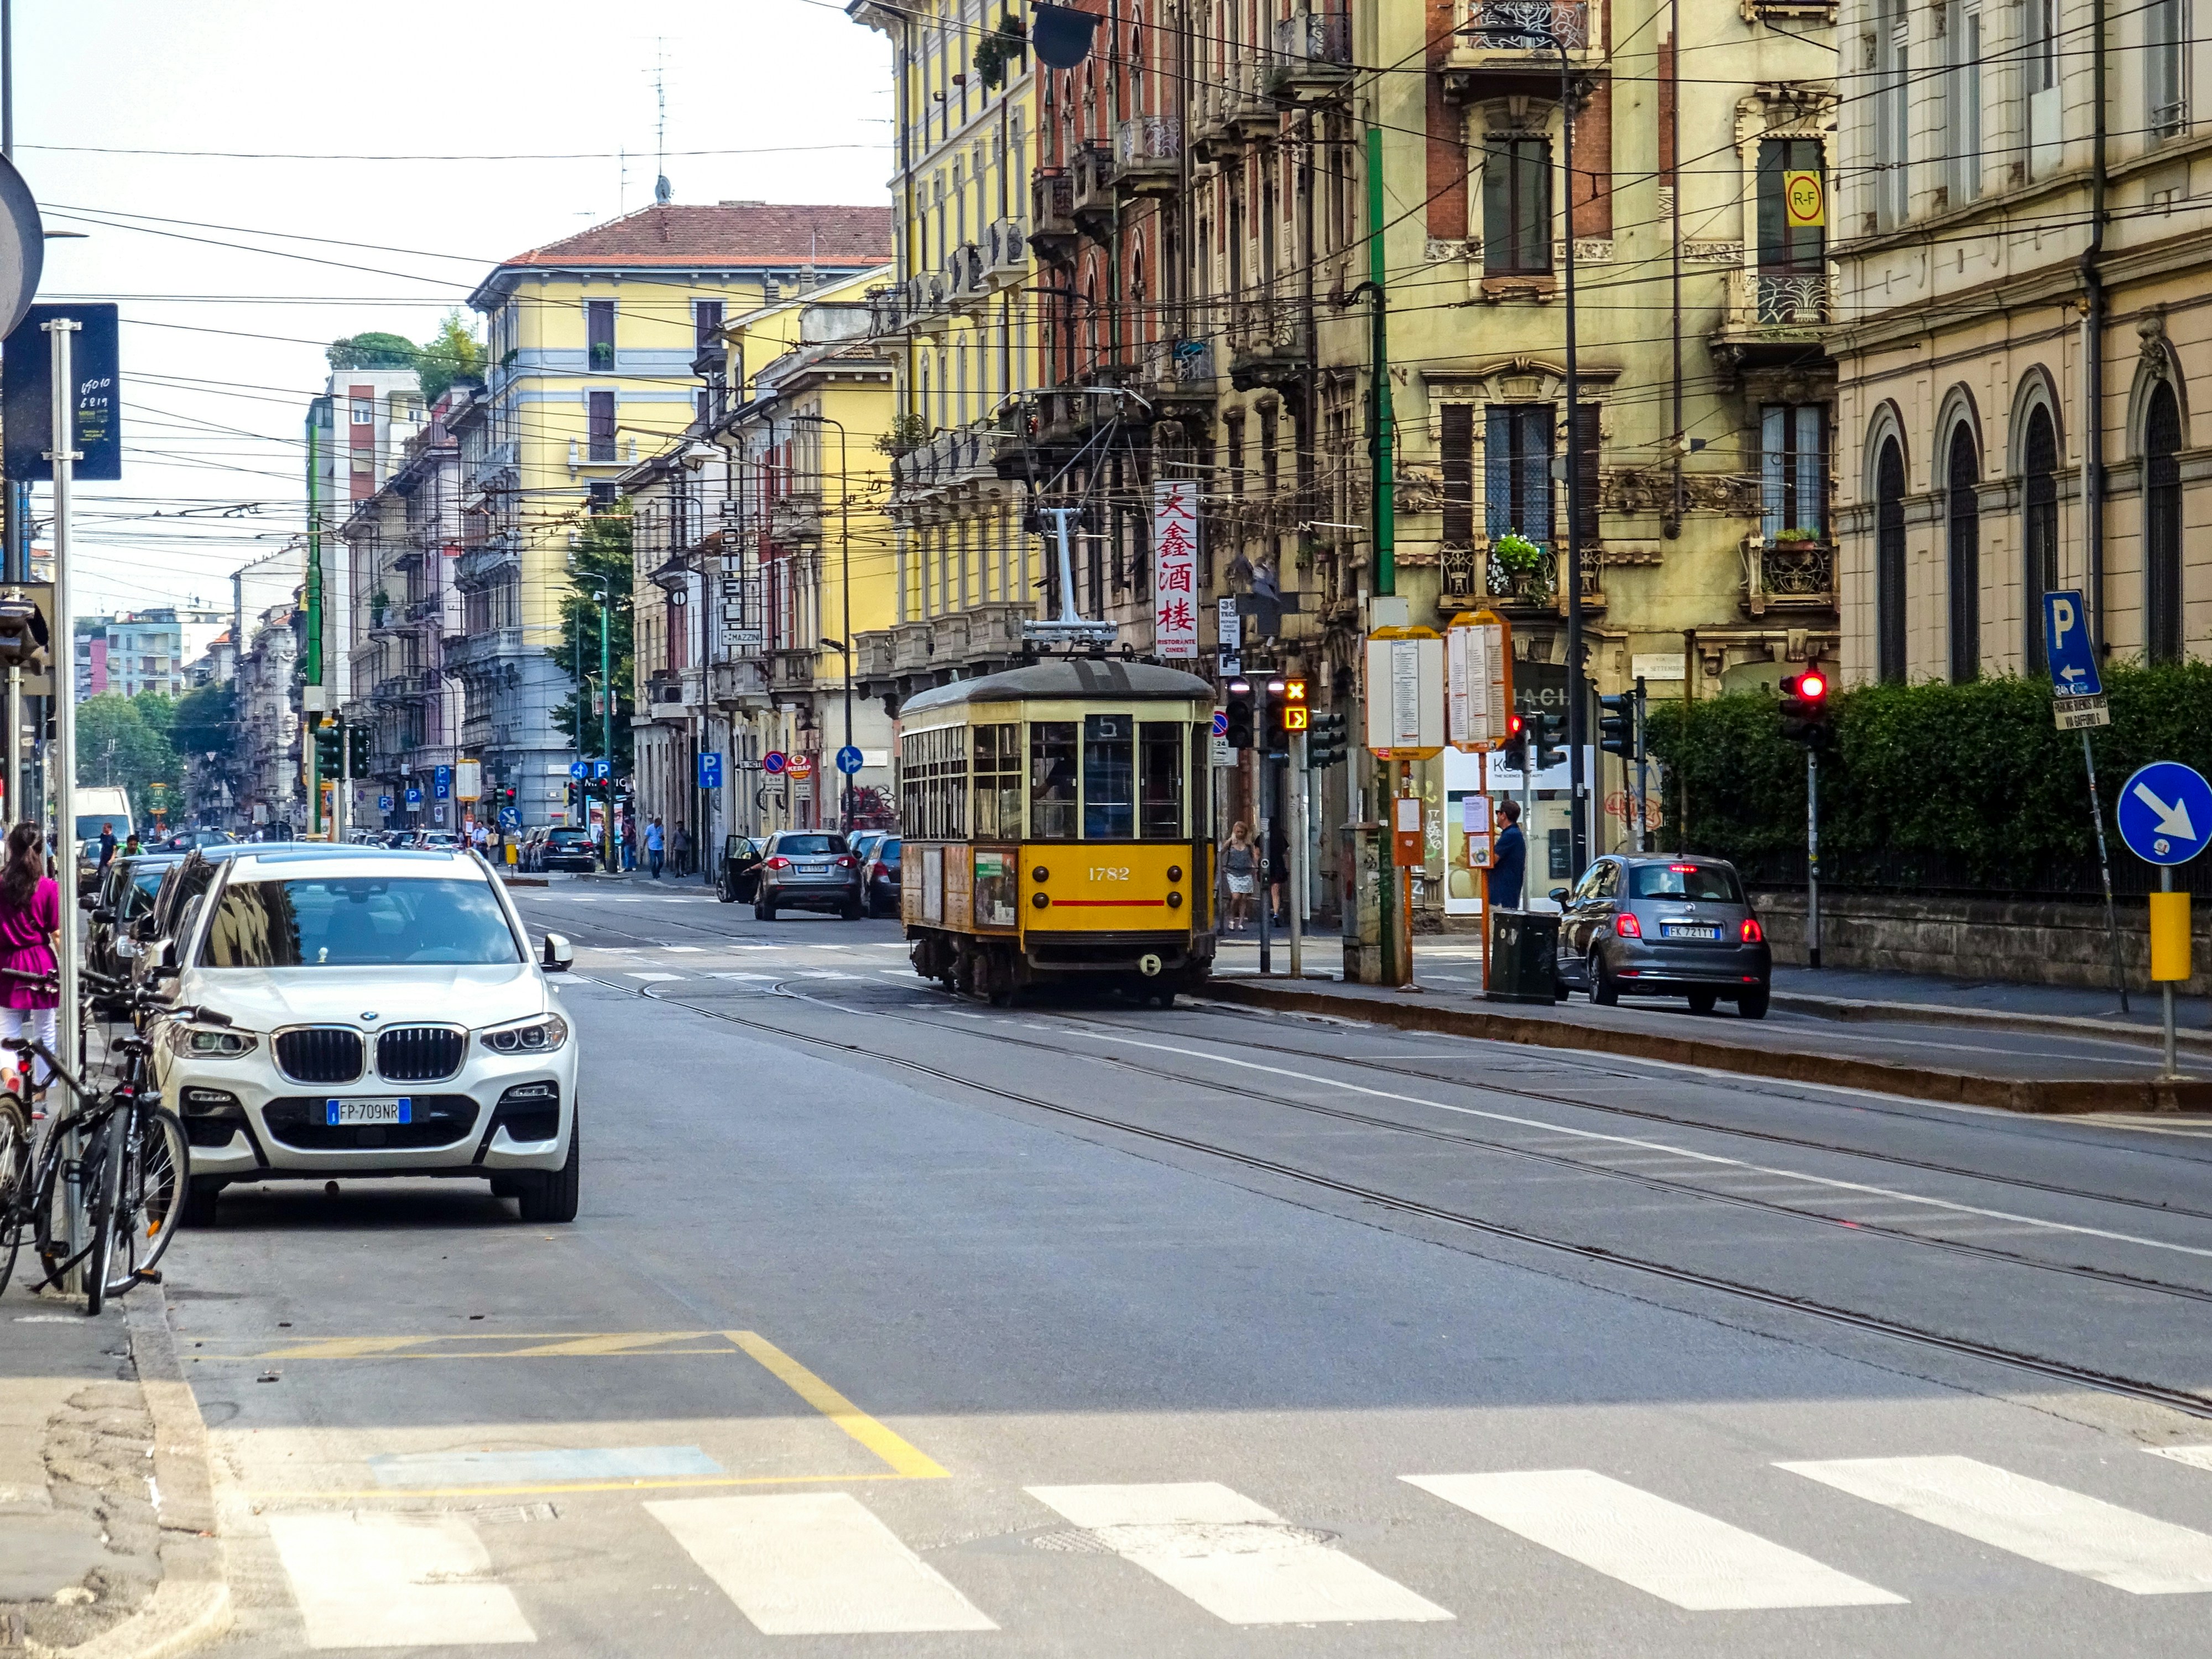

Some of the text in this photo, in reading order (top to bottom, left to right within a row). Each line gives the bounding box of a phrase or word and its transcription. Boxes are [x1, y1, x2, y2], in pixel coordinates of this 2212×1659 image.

[1794, 192, 1814, 205] R-F
[721, 502, 739, 622] HOTEL
[2053, 599, 2074, 649] P
[732, 632, 760, 641] MAZZINI
[1513, 688, 1570, 706] ACI
[1099, 716, 1117, 737] 5
[703, 755, 716, 772] P
[438, 767, 446, 776] P
[598, 764, 608, 778] P
[409, 791, 416, 800] P
[437, 786, 445, 796] P
[1089, 867, 1129, 881] 1782
[1671, 927, 1714, 937] FK 721YY
[359, 1105, 398, 1119] 709NR
